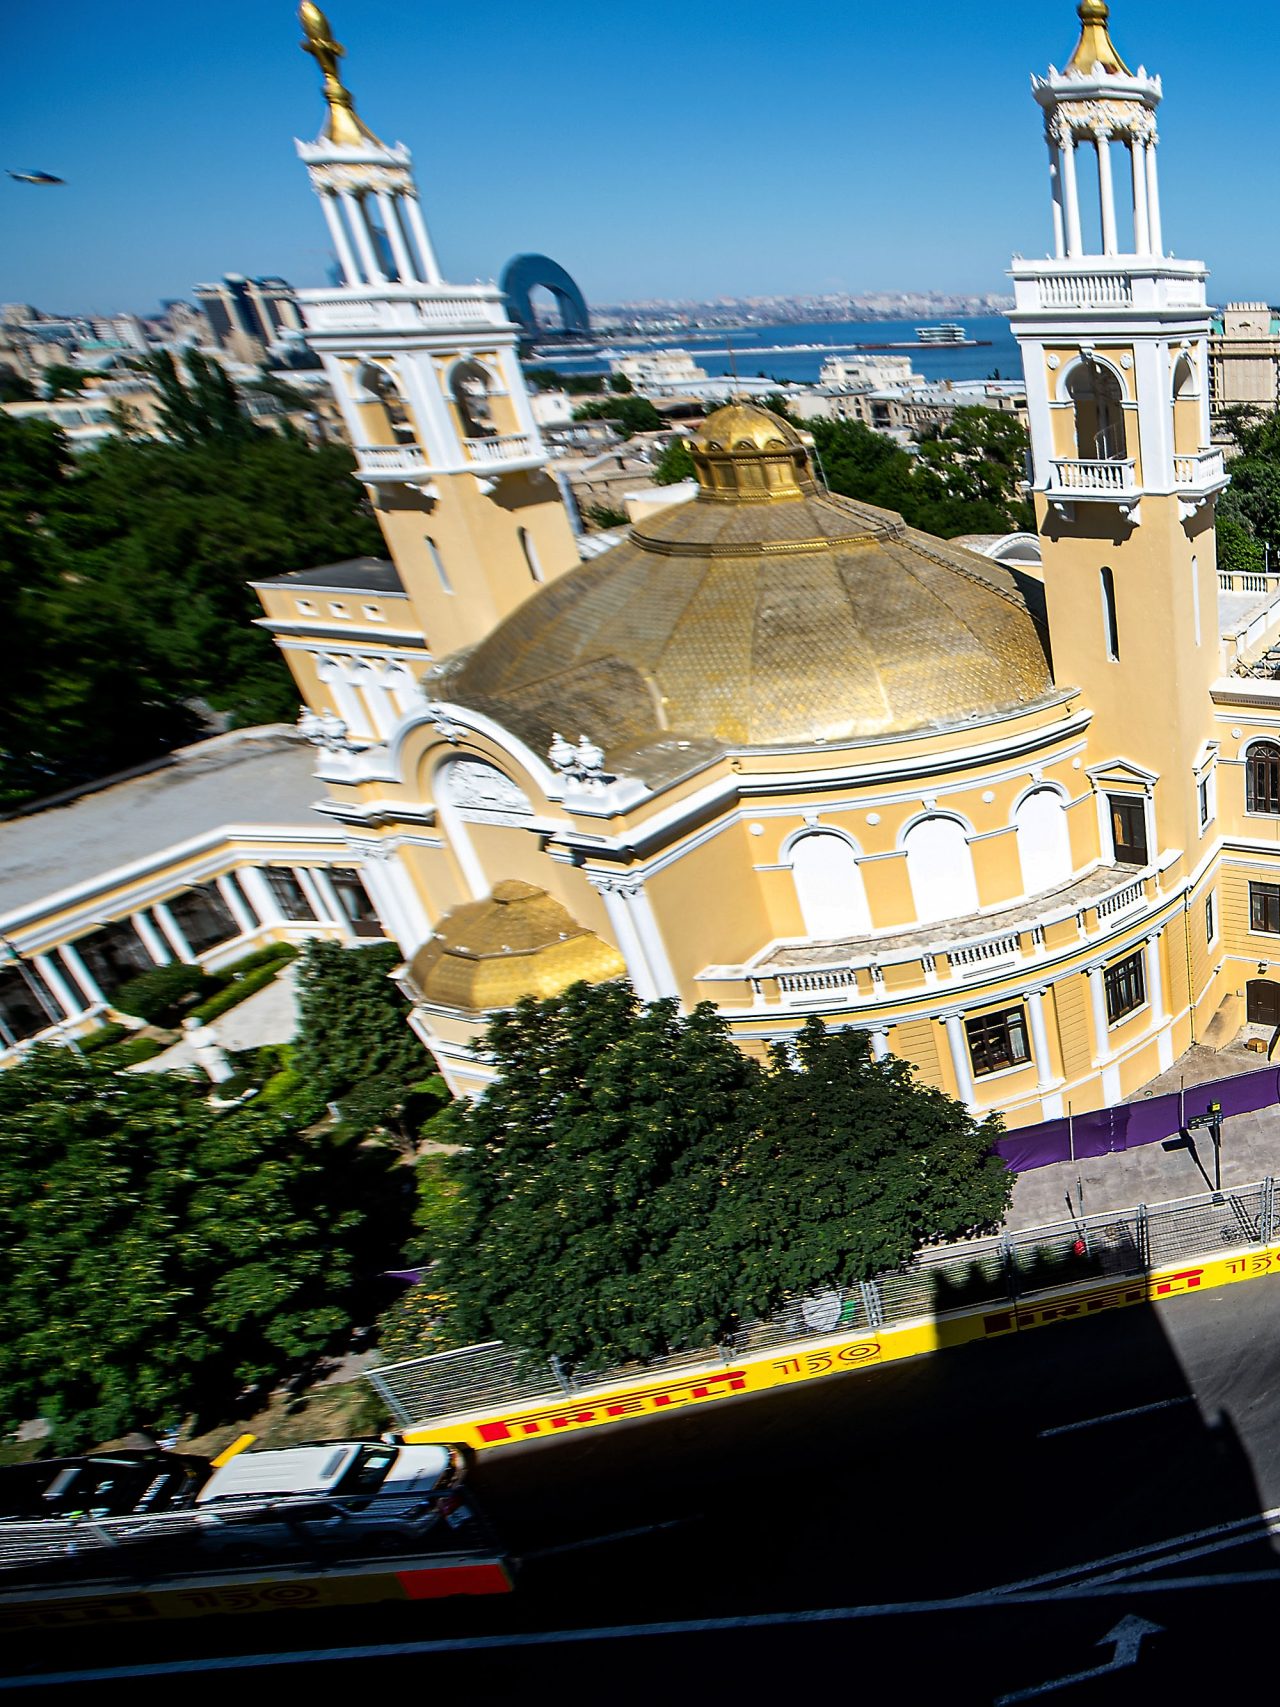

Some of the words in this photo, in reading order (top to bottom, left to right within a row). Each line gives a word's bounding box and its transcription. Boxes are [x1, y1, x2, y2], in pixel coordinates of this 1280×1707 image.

[983, 1268, 1204, 1334] PIRELLI
[771, 1343, 881, 1375] 150
[475, 1370, 746, 1443] PIRELLI
[178, 1584, 319, 1611] 150
